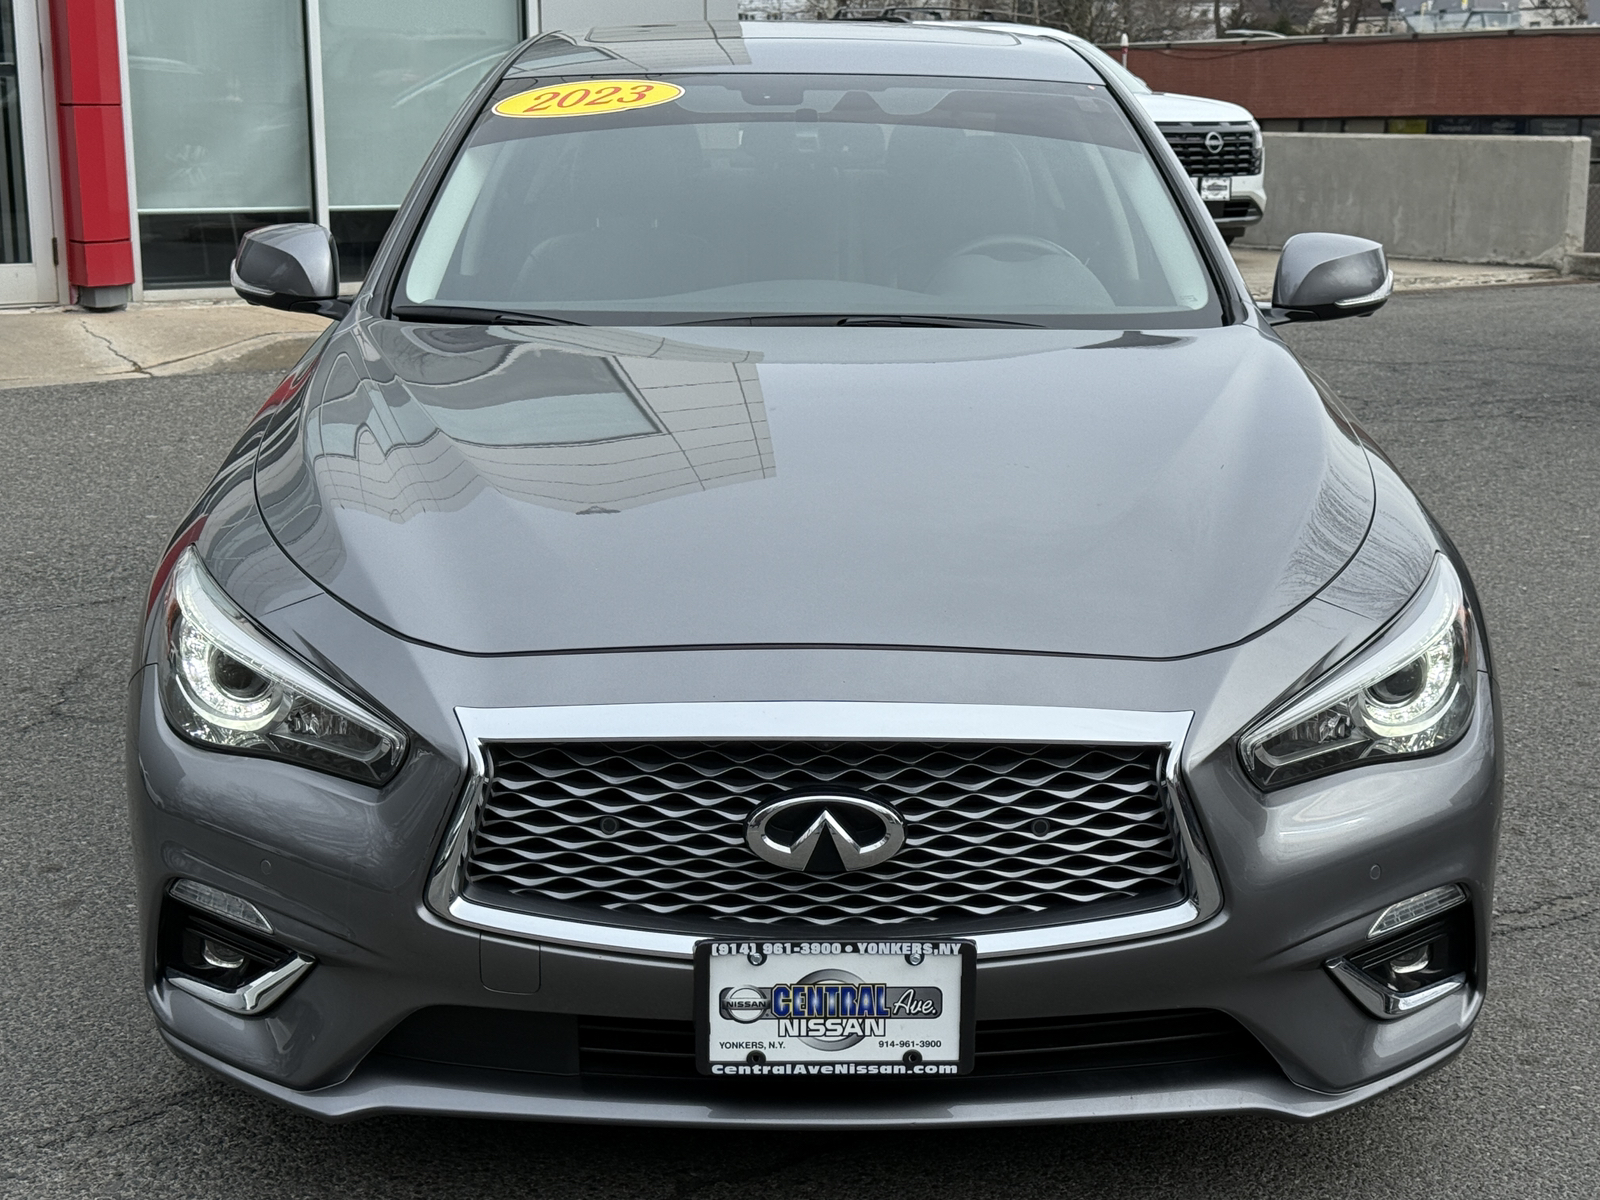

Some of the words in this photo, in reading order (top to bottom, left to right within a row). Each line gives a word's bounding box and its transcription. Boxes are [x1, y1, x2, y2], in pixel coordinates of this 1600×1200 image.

[522, 84, 655, 113] 2023
[711, 943, 757, 957] (914)
[762, 942, 842, 955] 961-3900
[726, 1000, 766, 1008] NISSAN
[772, 983, 891, 1018] CENTRAL
[893, 988, 937, 1015] Ave.
[778, 1018, 886, 1037] NISSAN
[719, 1041, 767, 1050] YONKERS,
[768, 1041, 786, 1050] N.Y.
[878, 1040, 942, 1048] 914-961-3900
[711, 1063, 958, 1075] CentralAveNissan.com
